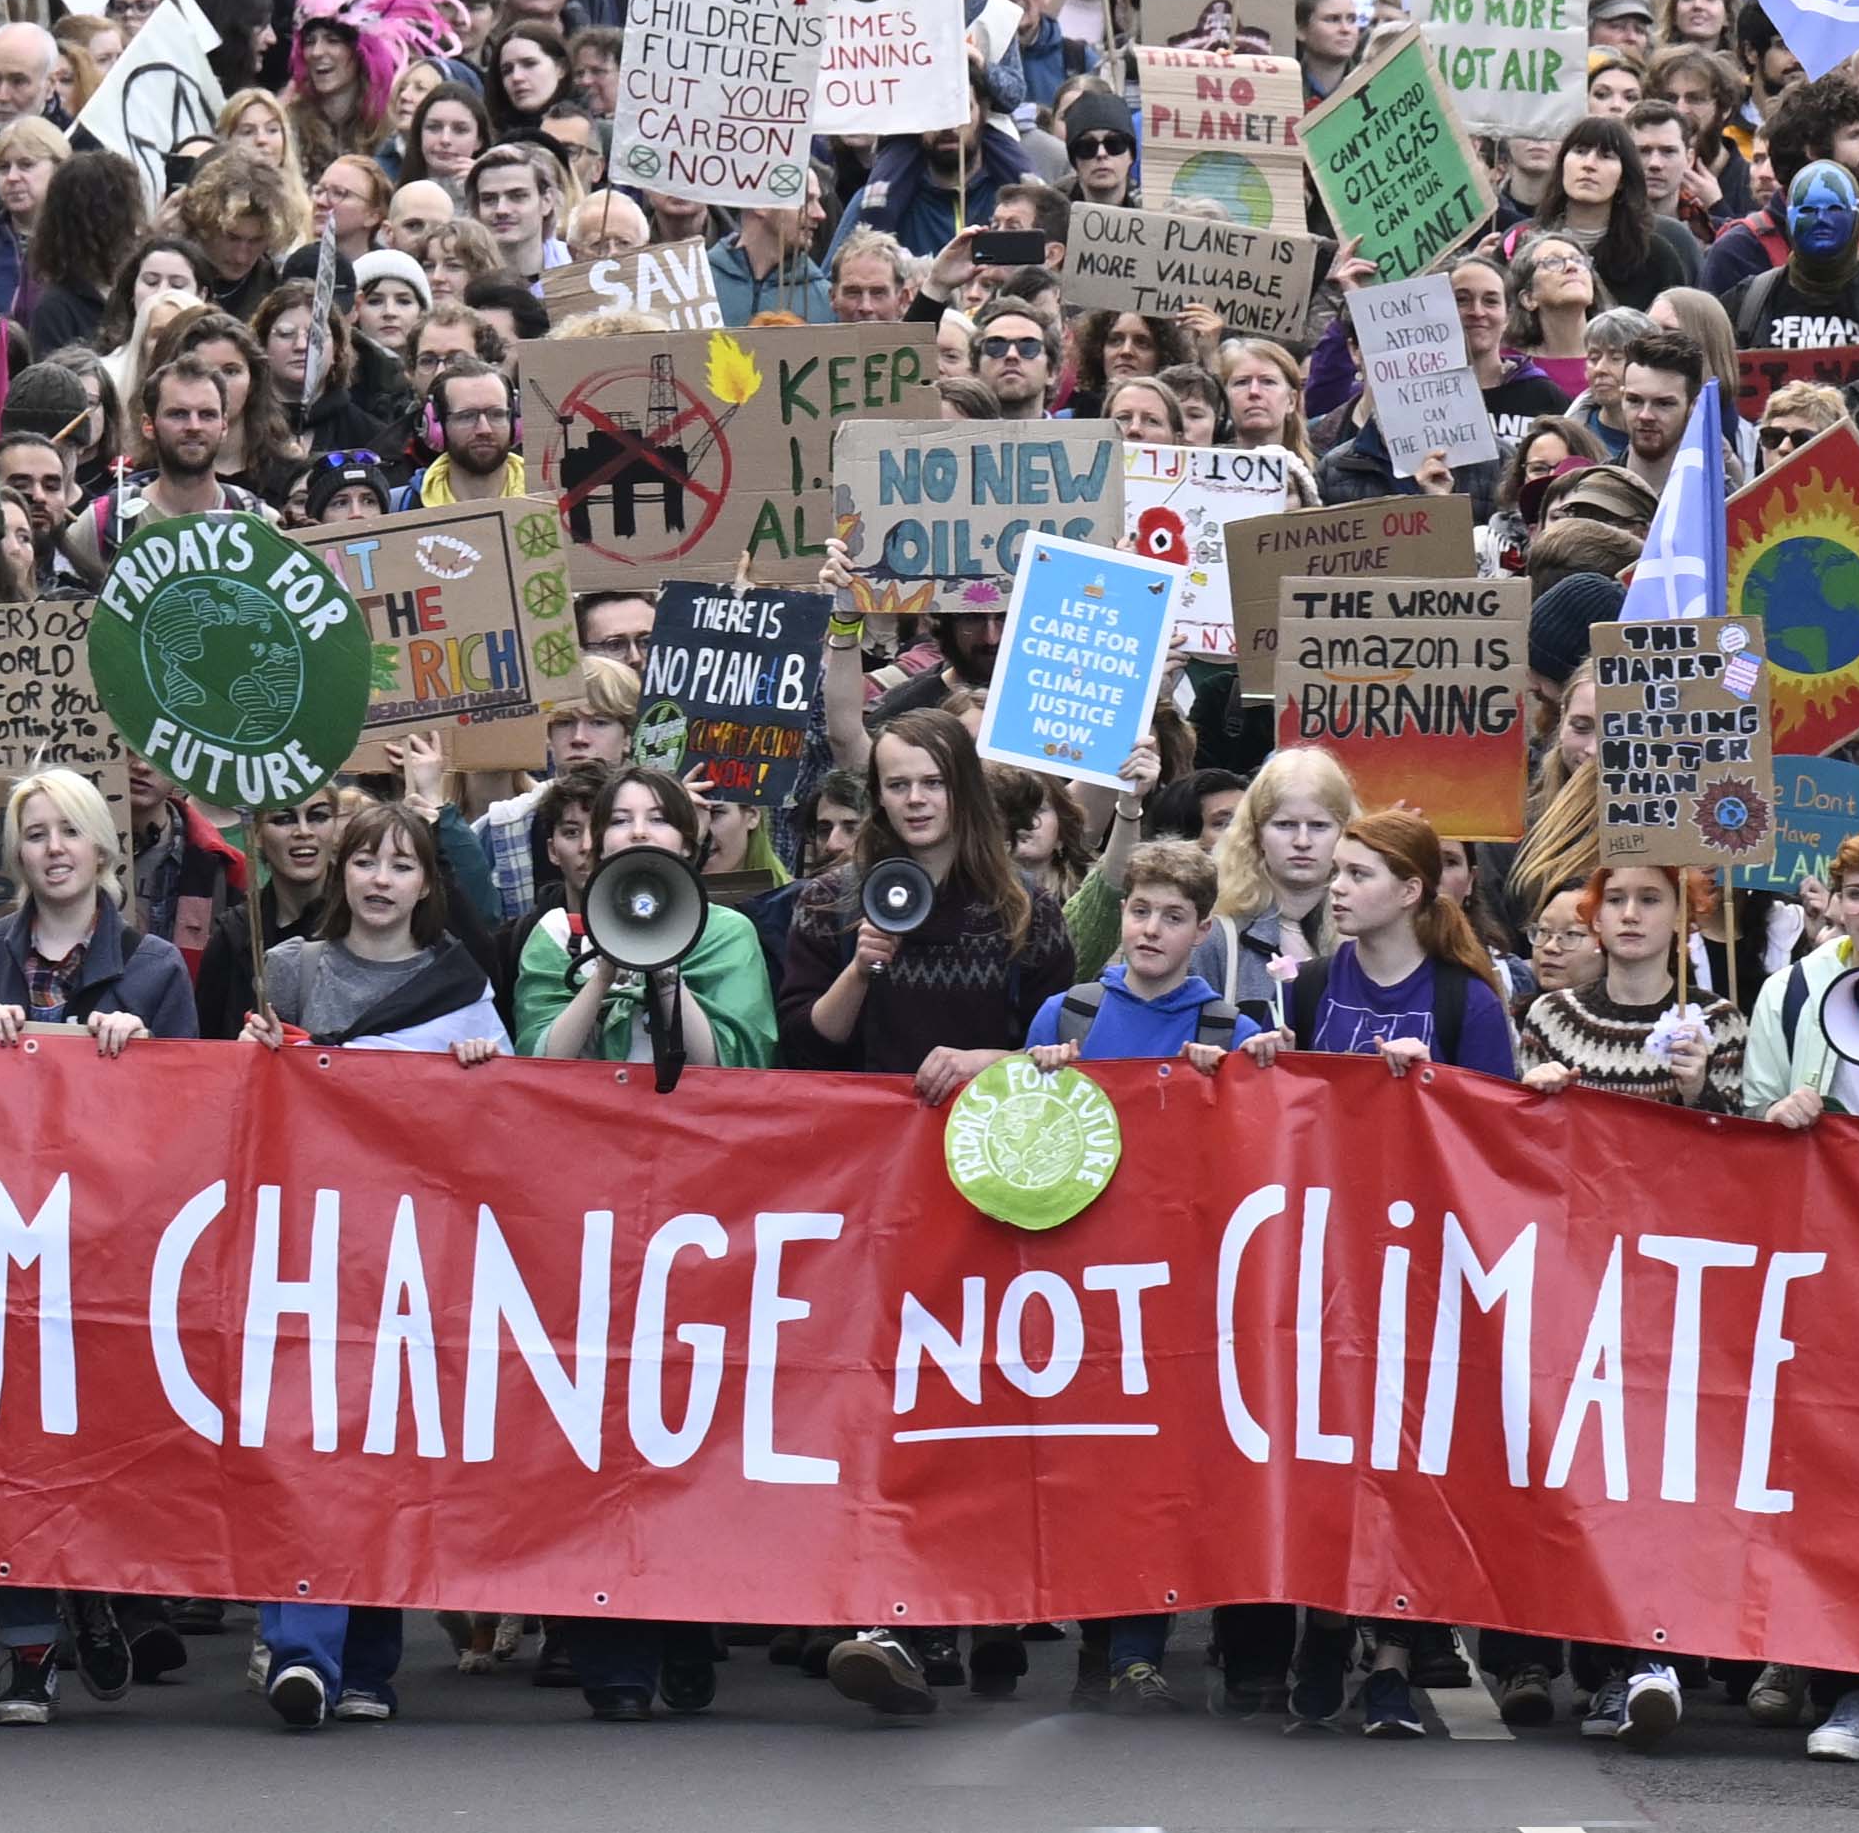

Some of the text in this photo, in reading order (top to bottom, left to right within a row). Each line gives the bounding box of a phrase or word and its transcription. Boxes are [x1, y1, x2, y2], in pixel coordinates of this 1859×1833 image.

[643, 34, 796, 83] FUTURE
[820, 41, 932, 70] UNNING
[1147, 51, 1279, 74] THERE IS
[1503, 48, 1563, 94] AIR
[628, 69, 809, 119] CUT YOUR
[827, 79, 901, 107] OUT
[1196, 76, 1255, 106] NO
[1360, 85, 1375, 122] I
[1151, 105, 1278, 142] PLANET
[1372, 82, 1425, 142] AFFORD
[638, 109, 794, 156] CARBON
[669, 152, 770, 190] NOW
[1345, 164, 1387, 205] OIL
[1372, 159, 1433, 215] NEITHER
[1375, 176, 1444, 238] CAN OUR
[1082, 210, 1295, 264] OUR PLANET IS
[1375, 184, 1477, 284] PLANET
[1076, 251, 1283, 299] MORE VALUABLE
[1213, 300, 1301, 336] MONEY!
[779, 345, 922, 426] KEEP
[878, 447, 961, 506] NO
[971, 440, 1112, 504] NEW
[100, 520, 348, 641] FRIDAYS FOR
[692, 596, 785, 639] THERE IS
[1292, 591, 1500, 618] THE WRONG
[1030, 616, 1139, 655] CARE FOR
[1299, 636, 1458, 670] amazon
[1623, 624, 1698, 651] THE
[409, 629, 521, 701] RICH
[644, 644, 689, 697] NO
[777, 653, 809, 711] B.
[1022, 639, 1141, 678] CREATION.
[441, 695, 466, 711] NOT
[1028, 669, 1123, 705] CLIMATE
[1645, 683, 1678, 711] IS
[471, 703, 539, 723] CAPITALISM
[1029, 694, 1114, 727] JUSTICE
[1299, 683, 1518, 739] BURNING
[1602, 705, 1759, 738] GETTING
[1033, 718, 1095, 747] NOW.
[143, 717, 324, 804] FUTURE
[1601, 737, 1752, 772] HOTTER
[1602, 773, 1698, 796] THAN
[1606, 798, 1679, 830] ME!
[951, 1084, 999, 1183] FRIDAYS
[1068, 1080, 1115, 1187] FUTURE
[150, 1177, 844, 1485] CHANGE
[893, 1261, 1172, 1414] NOT
